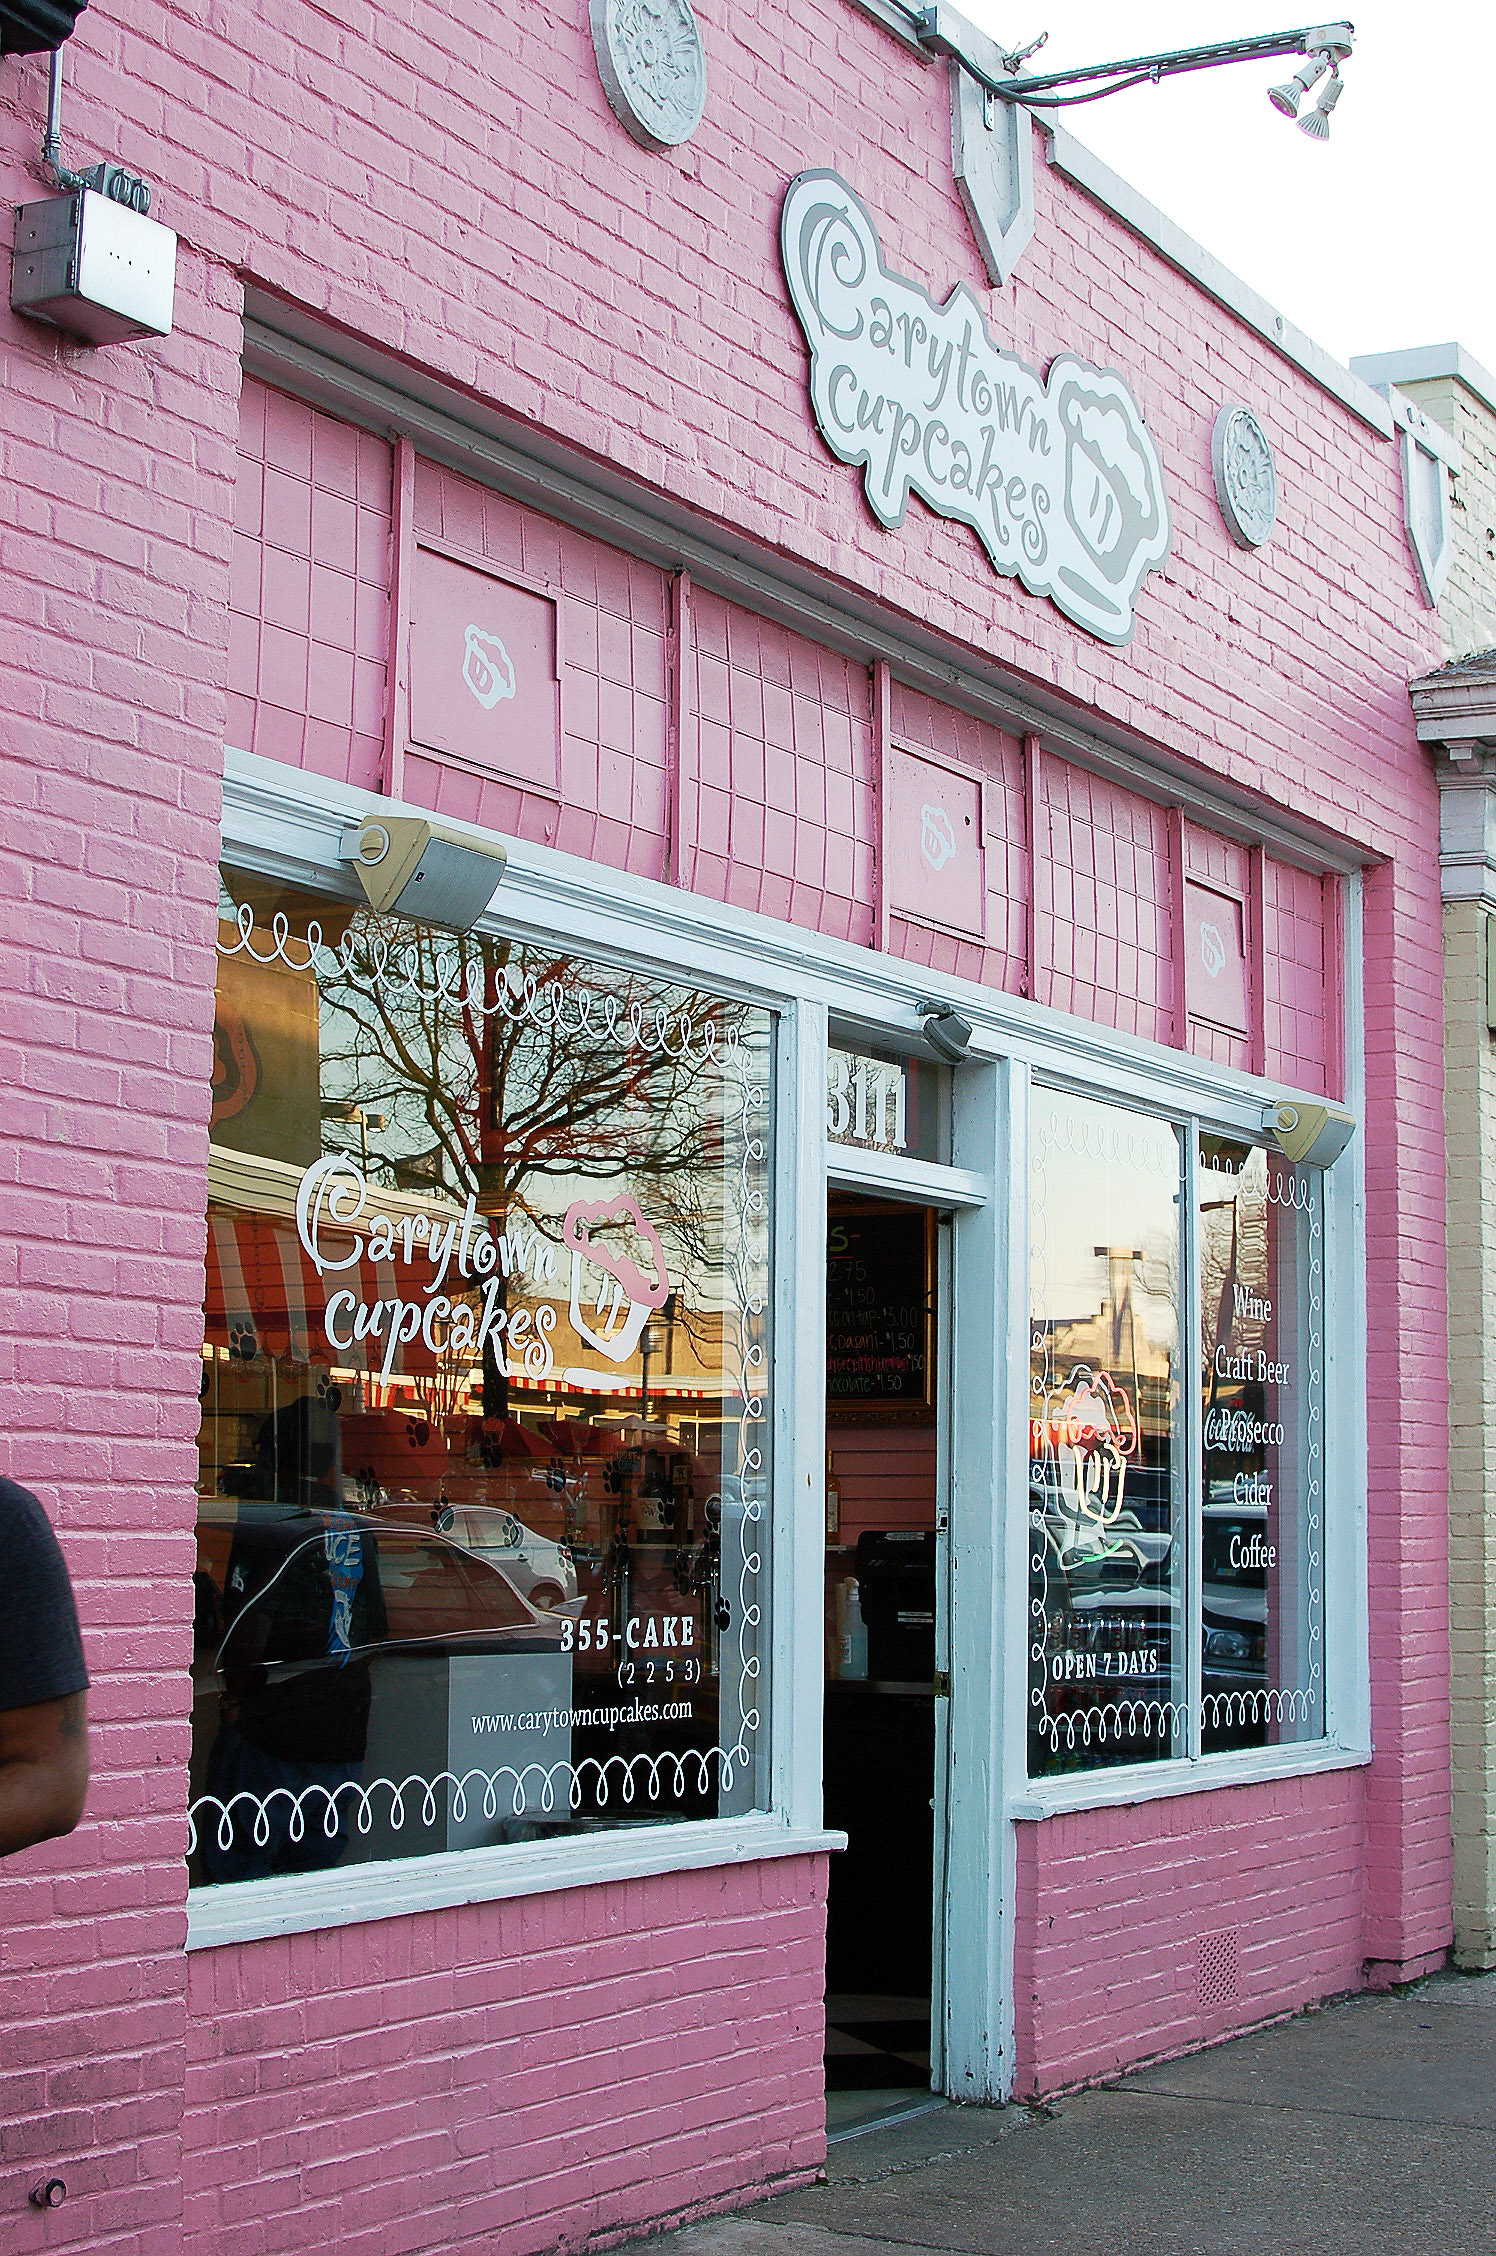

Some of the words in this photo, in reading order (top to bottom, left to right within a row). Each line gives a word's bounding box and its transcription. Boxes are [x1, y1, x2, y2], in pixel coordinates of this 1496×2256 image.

[799, 202, 1051, 455] Carytown
[296, 1150, 557, 1294] Carytown
[1232, 1283, 1272, 1323] Wine
[1215, 1344, 1254, 1382] Craft
[1257, 1349, 1289, 1385] Beer
[1221, 1408, 1285, 1446] Prosecco
[1233, 1471, 1273, 1506] Cider
[1230, 1533, 1276, 1569] Coffee
[560, 1616, 694, 1652] 355-CAKE
[1052, 1653, 1096, 1681] OPEN
[1103, 1652, 1112, 1677] 7
[1118, 1649, 1157, 1675] DAYS
[471, 1697, 693, 1737] www.carytowncupcakes.com
